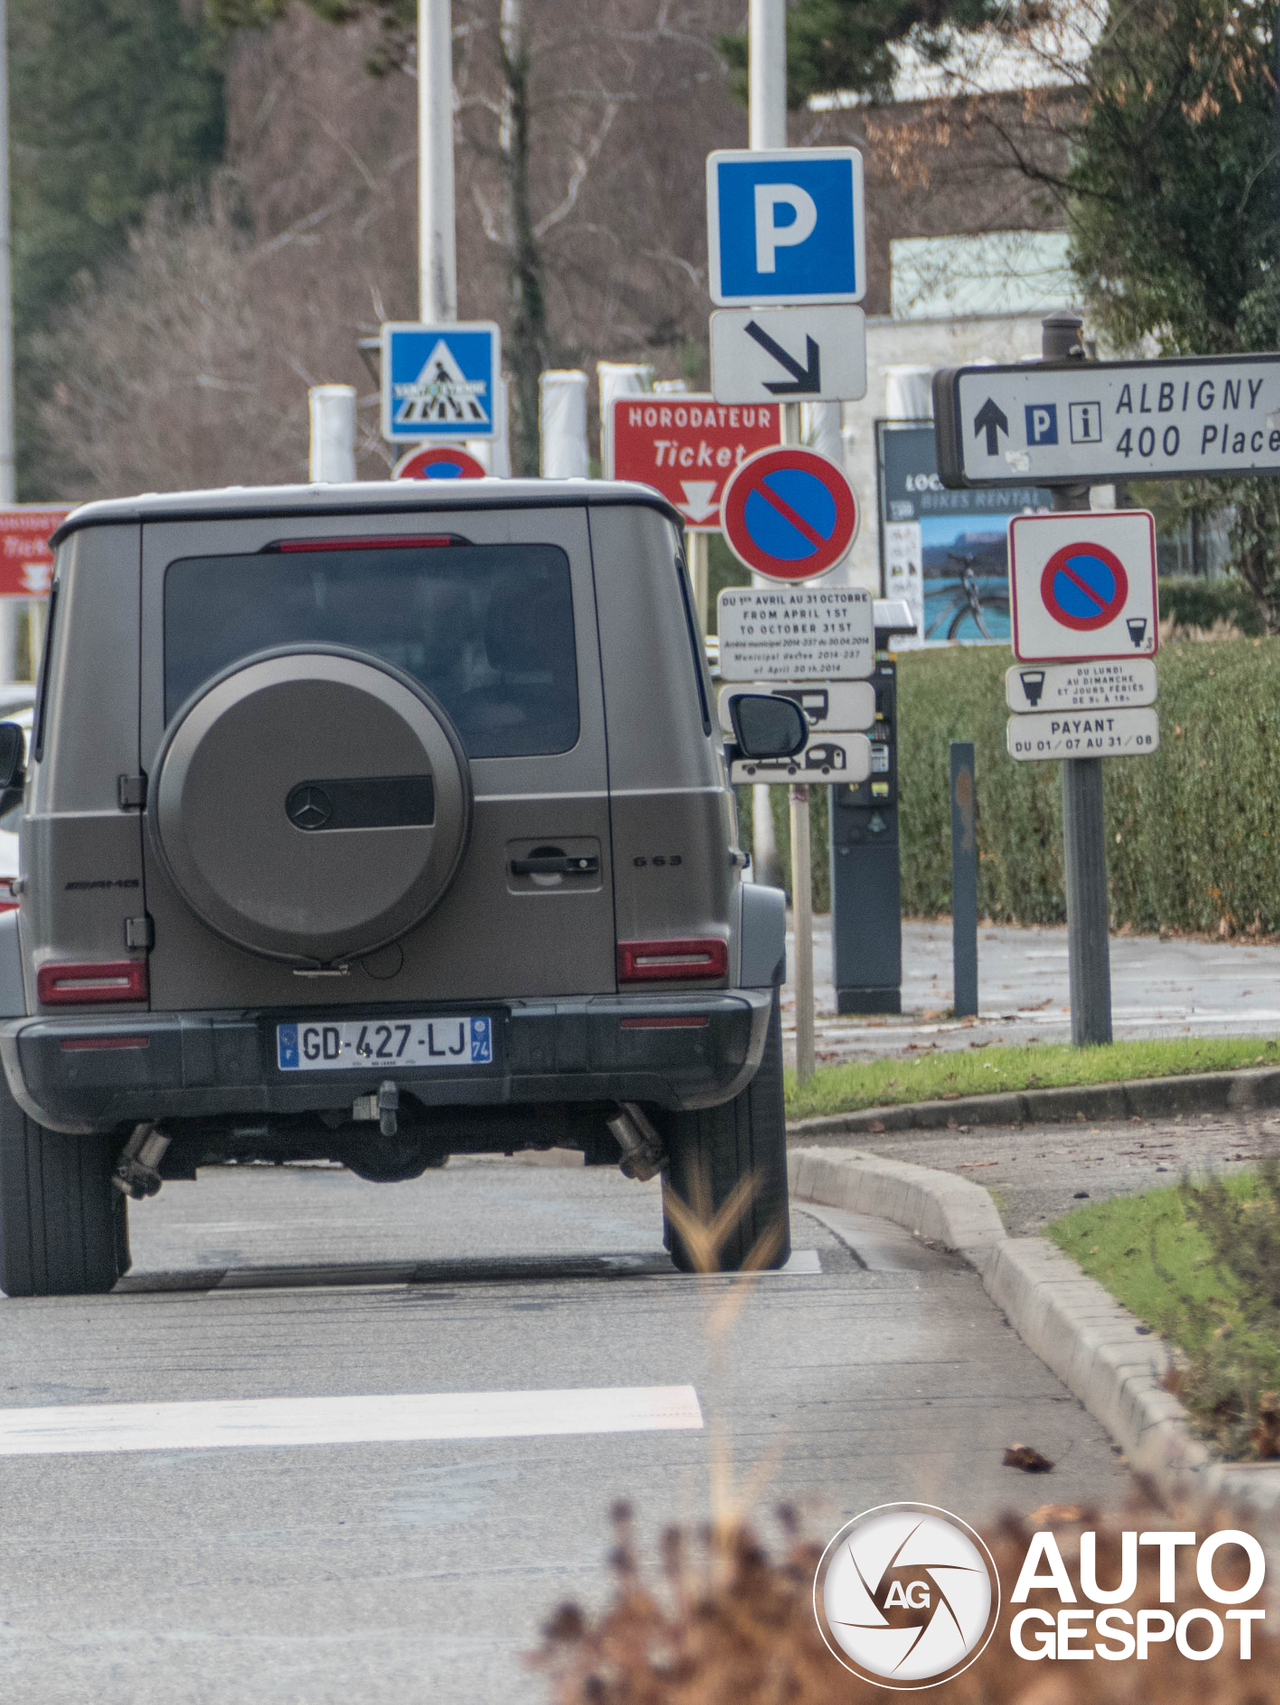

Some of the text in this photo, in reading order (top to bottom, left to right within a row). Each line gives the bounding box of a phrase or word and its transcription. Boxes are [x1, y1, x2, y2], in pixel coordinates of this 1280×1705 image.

[754, 183, 818, 273] P
[1115, 378, 1264, 415] ALBIGNY
[628, 406, 771, 428] HORODATEUR
[1116, 424, 1180, 458] 400
[653, 439, 747, 468] Ticket
[920, 489, 1040, 509] BIKES RENTAL
[722, 598, 736, 607] DU
[756, 595, 787, 605] AVRIL
[789, 594, 803, 604] AU
[806, 594, 818, 604] 31
[820, 592, 868, 604] OCTOBRE
[743, 609, 777, 620] FROM
[783, 608, 820, 619] APRIL
[740, 623, 853, 635] TO OCTOBER 31ST
[734, 652, 780, 662] Municipal
[767, 665, 790, 675] April
[1077, 666, 1123, 676] DU LUNDI
[1067, 675, 1134, 686] AU DIMANCHE
[1057, 687, 1068, 696] ET
[1073, 686, 1105, 695] JOURS
[1072, 696, 1084, 705] DE
[1051, 718, 1115, 735] PAYANT
[1015, 741, 1032, 753] DU
[1086, 737, 1103, 748] AU
[303, 1022, 465, 1060] GD-427-LJ
[472, 1042, 489, 1058] 74
